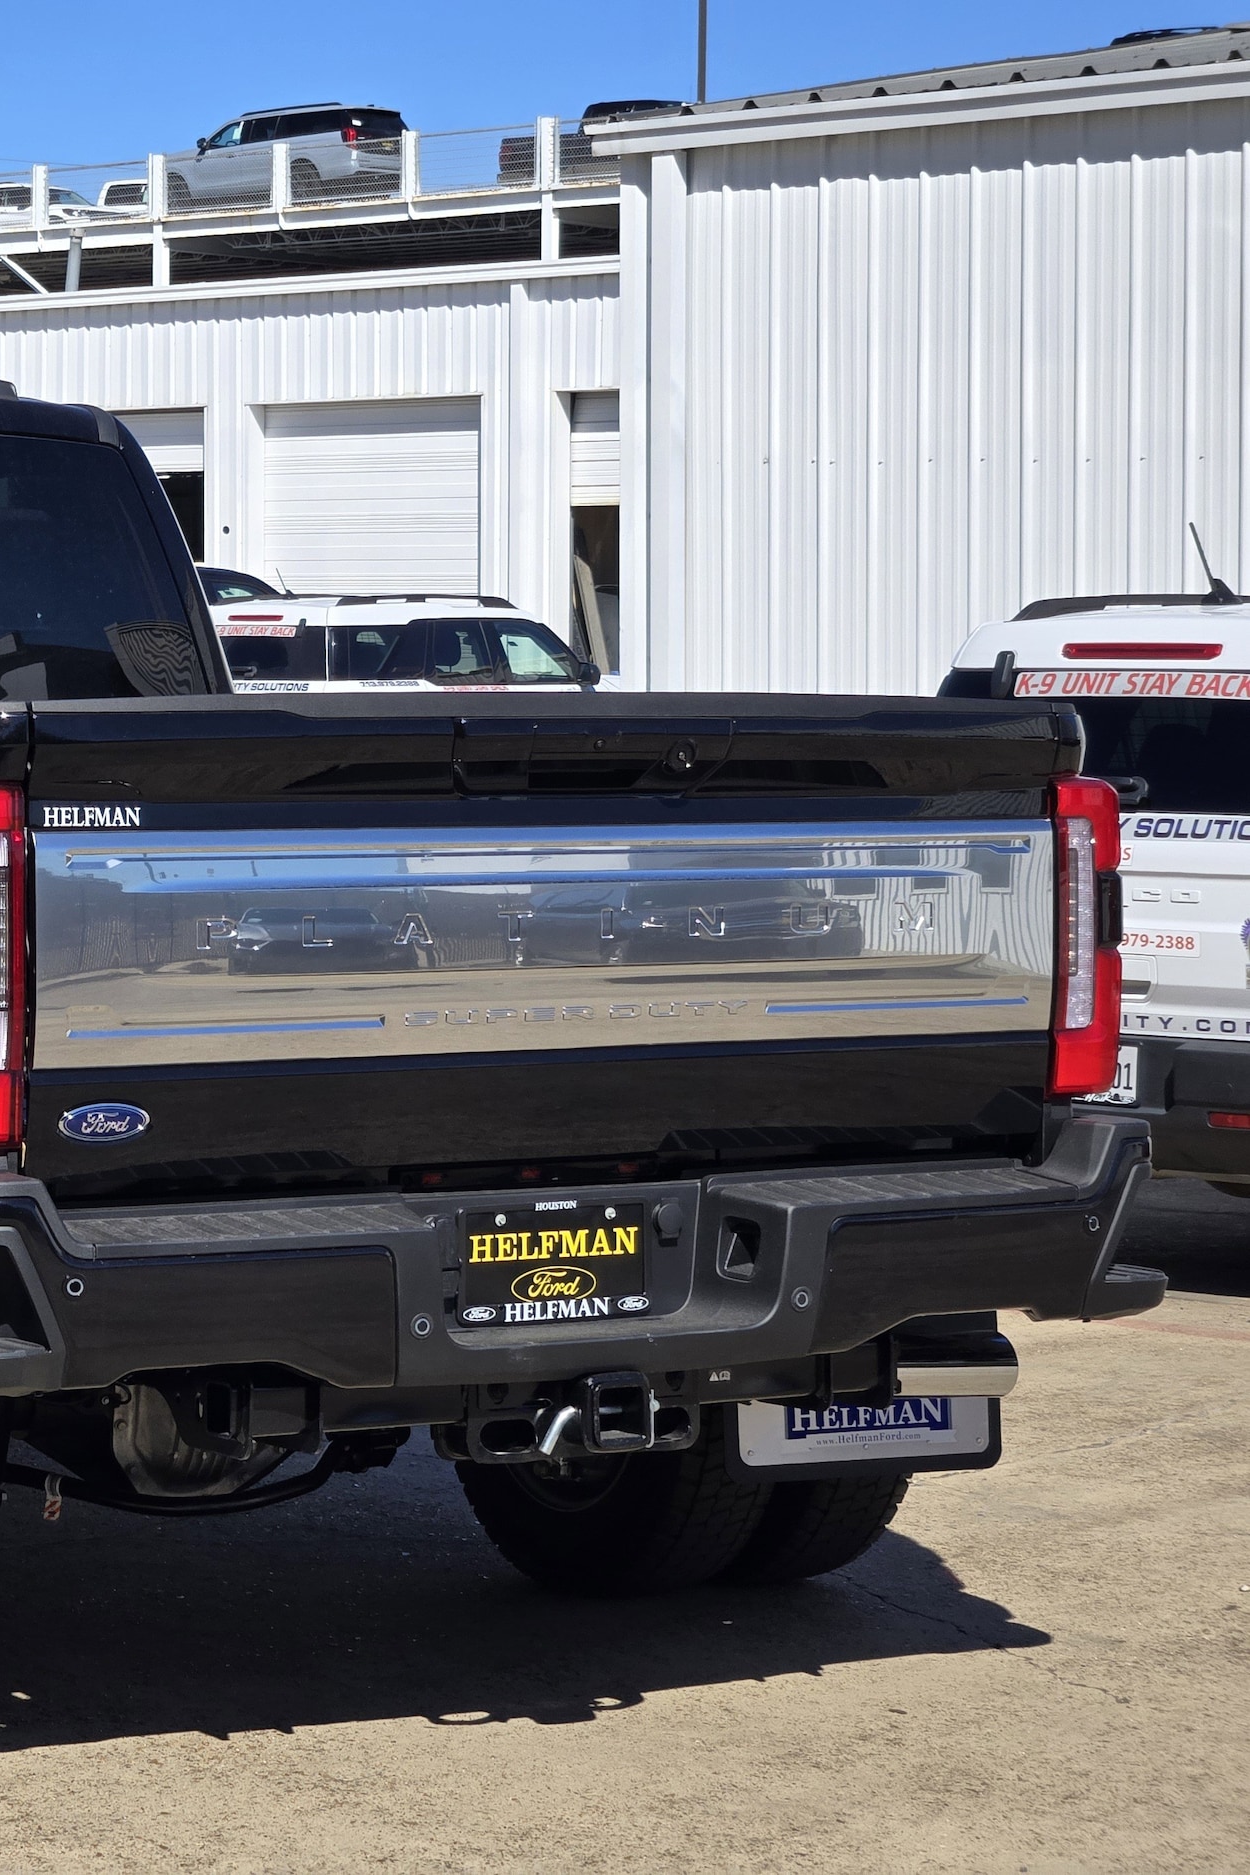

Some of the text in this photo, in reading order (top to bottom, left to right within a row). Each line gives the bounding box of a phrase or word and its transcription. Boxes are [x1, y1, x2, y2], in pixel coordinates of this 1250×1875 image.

[217, 626, 295, 637] -9 UNIT STAY BACK
[249, 682, 310, 692] SOLUTIONS
[1015, 672, 1250, 697] K-9 UNIT STAY BACK
[42, 806, 142, 827] HELFMAN
[196, 900, 936, 951] PLATINUM
[404, 999, 749, 1027] SUPER DUTY
[1123, 1014, 1250, 1035] ITY.CO
[81, 1111, 131, 1134] Ford
[534, 1200, 578, 1212] HOUSTON
[468, 1226, 639, 1263] HELFMAN
[527, 1270, 581, 1298] Ford
[503, 1296, 611, 1323] HELFMAN
[791, 1397, 945, 1432] HELFMAN
[815, 1431, 922, 1446] www.HelfmanFord.com
